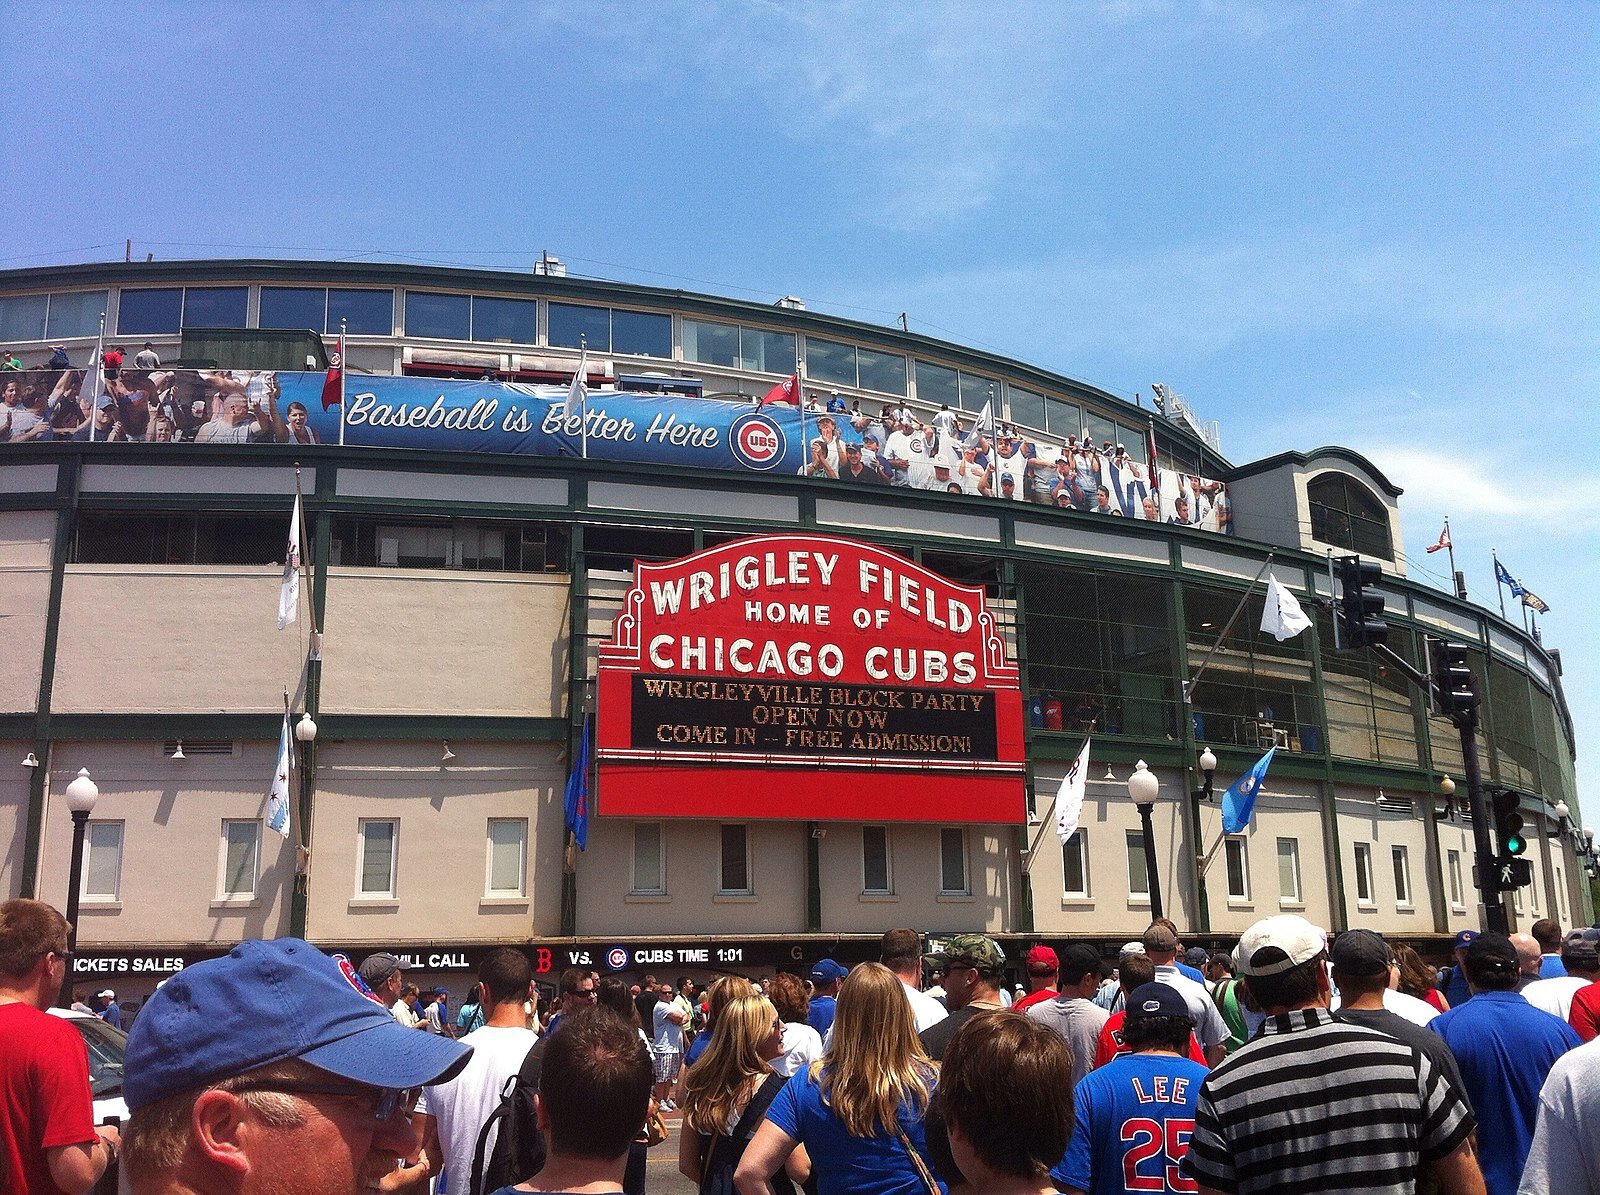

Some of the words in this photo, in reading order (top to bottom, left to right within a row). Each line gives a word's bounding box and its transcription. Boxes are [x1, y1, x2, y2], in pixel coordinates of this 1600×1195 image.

[346, 393, 495, 431] Baseball
[503, 405, 533, 433] is
[541, 402, 637, 442] Better
[645, 412, 720, 448] Here
[649, 551, 839, 616] WRIGLEY
[859, 559, 973, 634] FIELD
[745, 600, 831, 626] HOME
[852, 607, 891, 629] OF
[649, 634, 844, 677] CHICAGO
[865, 646, 977, 684] CUBS
[643, 679, 823, 706] WRIGLEYVILLE
[828, 688, 905, 709] BLOCK
[911, 693, 984, 712] PARTY
[752, 706, 818, 727] OPEN
[827, 710, 888, 729] NOW
[656, 724, 728, 744] COME
[734, 729, 757, 746] IN
[785, 730, 843, 749] FREE
[849, 732, 971, 754] ADMISSION!
[73, 958, 129, 972] ICKETS
[132, 958, 184, 972] SALES
[428, 953, 470, 968] CALL
[535, 947, 552, 973] B
[568, 951, 593, 965] VS.
[634, 949, 674, 964] CUBS
[676, 949, 709, 963] TIME
[716, 948, 743, 962] 1:01
[1131, 1076, 1190, 1105] LEE
[1120, 1117, 1199, 1194] 25
